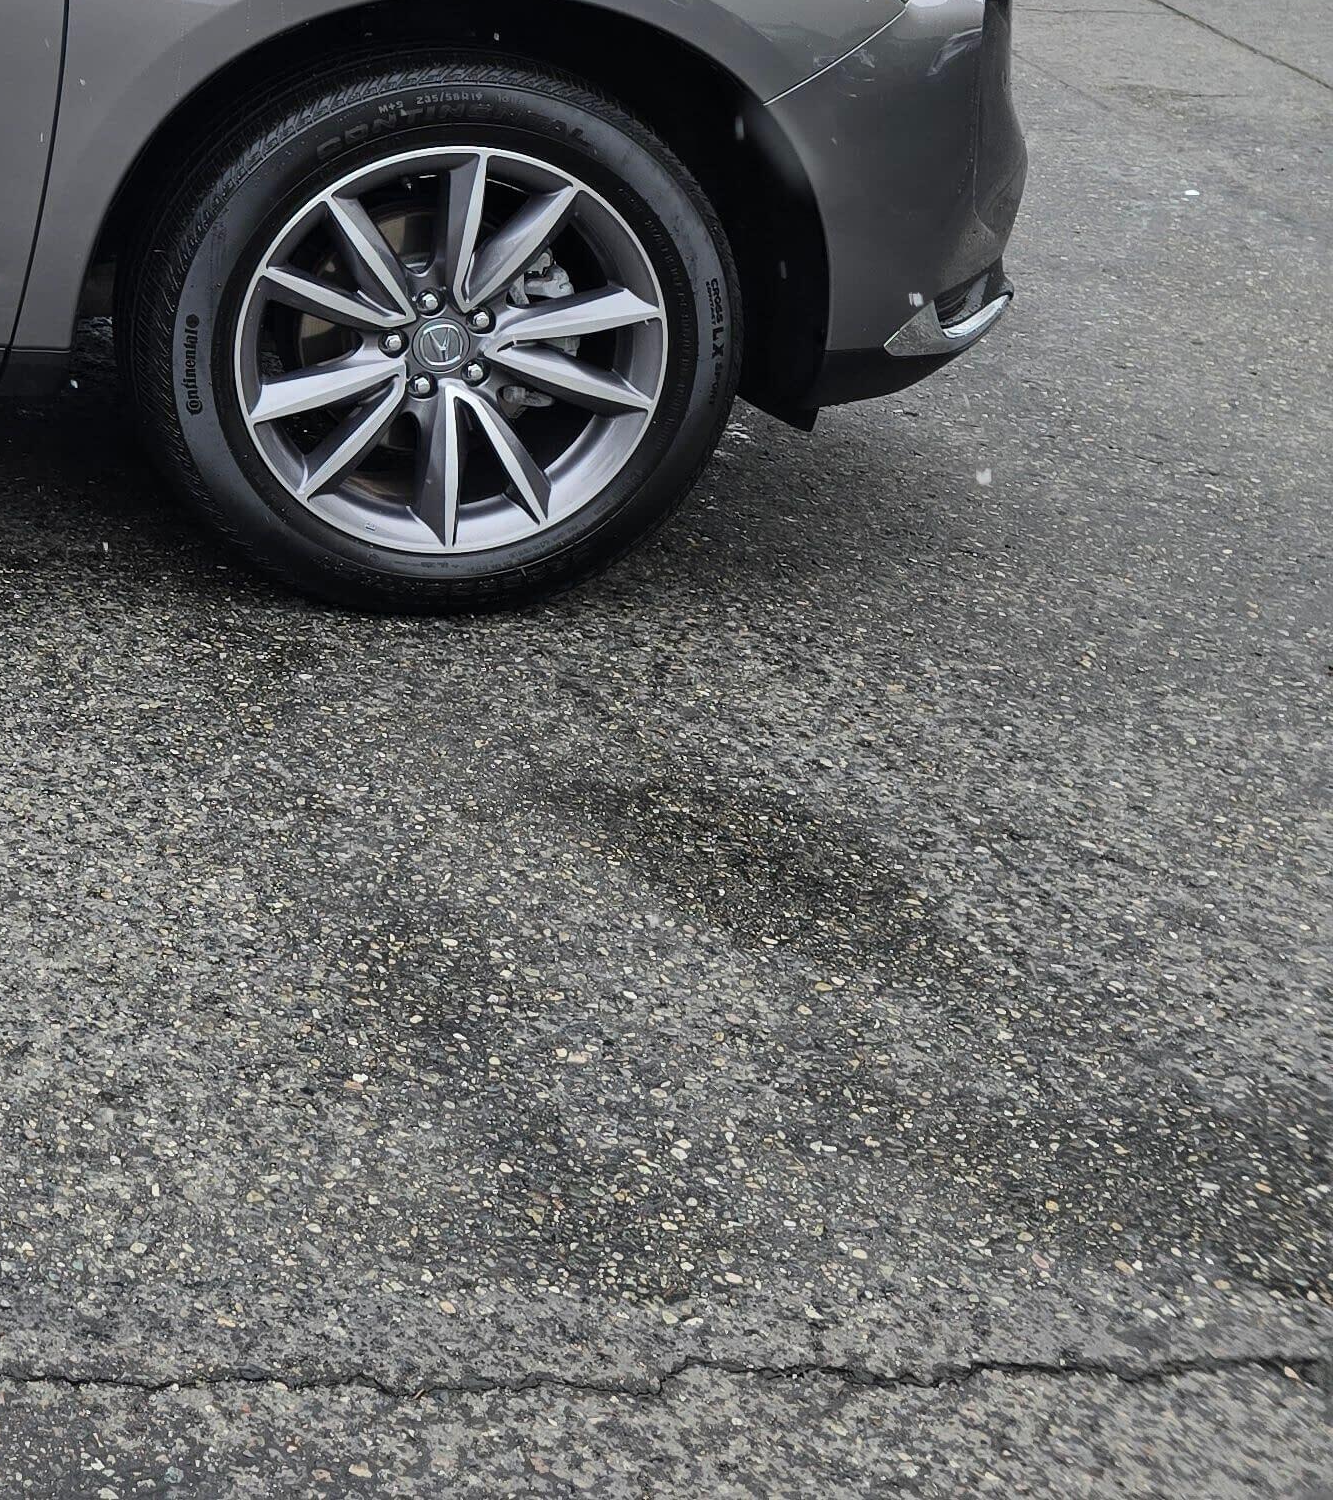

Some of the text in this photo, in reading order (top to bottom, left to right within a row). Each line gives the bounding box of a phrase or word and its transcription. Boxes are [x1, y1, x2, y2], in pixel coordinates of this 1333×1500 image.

[711, 278, 724, 324] CROSS
[712, 326, 725, 359] LX
[181, 327, 203, 416] Continental
